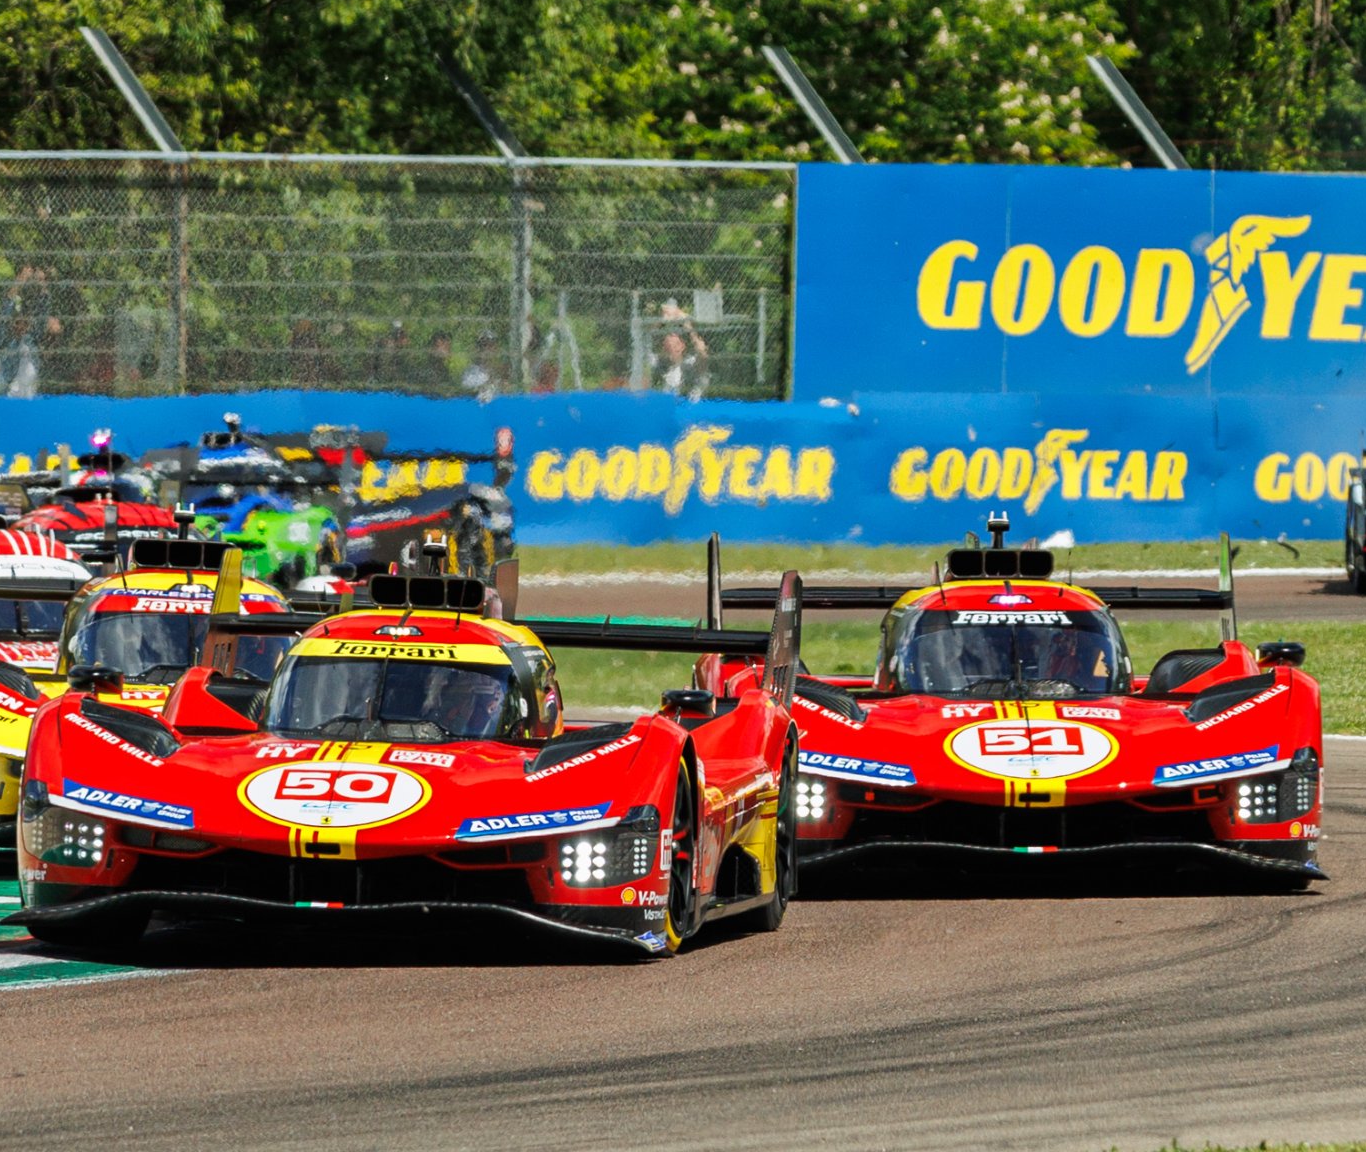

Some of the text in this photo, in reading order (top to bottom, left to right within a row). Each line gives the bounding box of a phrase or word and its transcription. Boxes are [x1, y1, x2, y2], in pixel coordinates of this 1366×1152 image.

[526, 446, 835, 503] GOODYEAR
[891, 446, 1188, 502] GOODYEAR
[112, 589, 194, 599] CHARLES
[952, 610, 1073, 625] Ferrari
[330, 640, 458, 660] Ferrari
[121, 691, 162, 700] HY
[941, 706, 987, 719] HY
[1195, 683, 1290, 732] RICHARD MILLE
[819, 708, 864, 731] MILLE
[64, 712, 120, 746] RICHARD
[119, 742, 165, 768] MILLE
[984, 728, 1080, 752] 51
[255, 746, 308, 759] HY
[525, 734, 642, 783] RICHARD MILLE
[797, 751, 863, 771] ADLER
[1162, 759, 1231, 778] ADLER
[281, 771, 390, 799] 50
[65, 787, 143, 810] ADLER
[469, 813, 550, 833] ADLER
